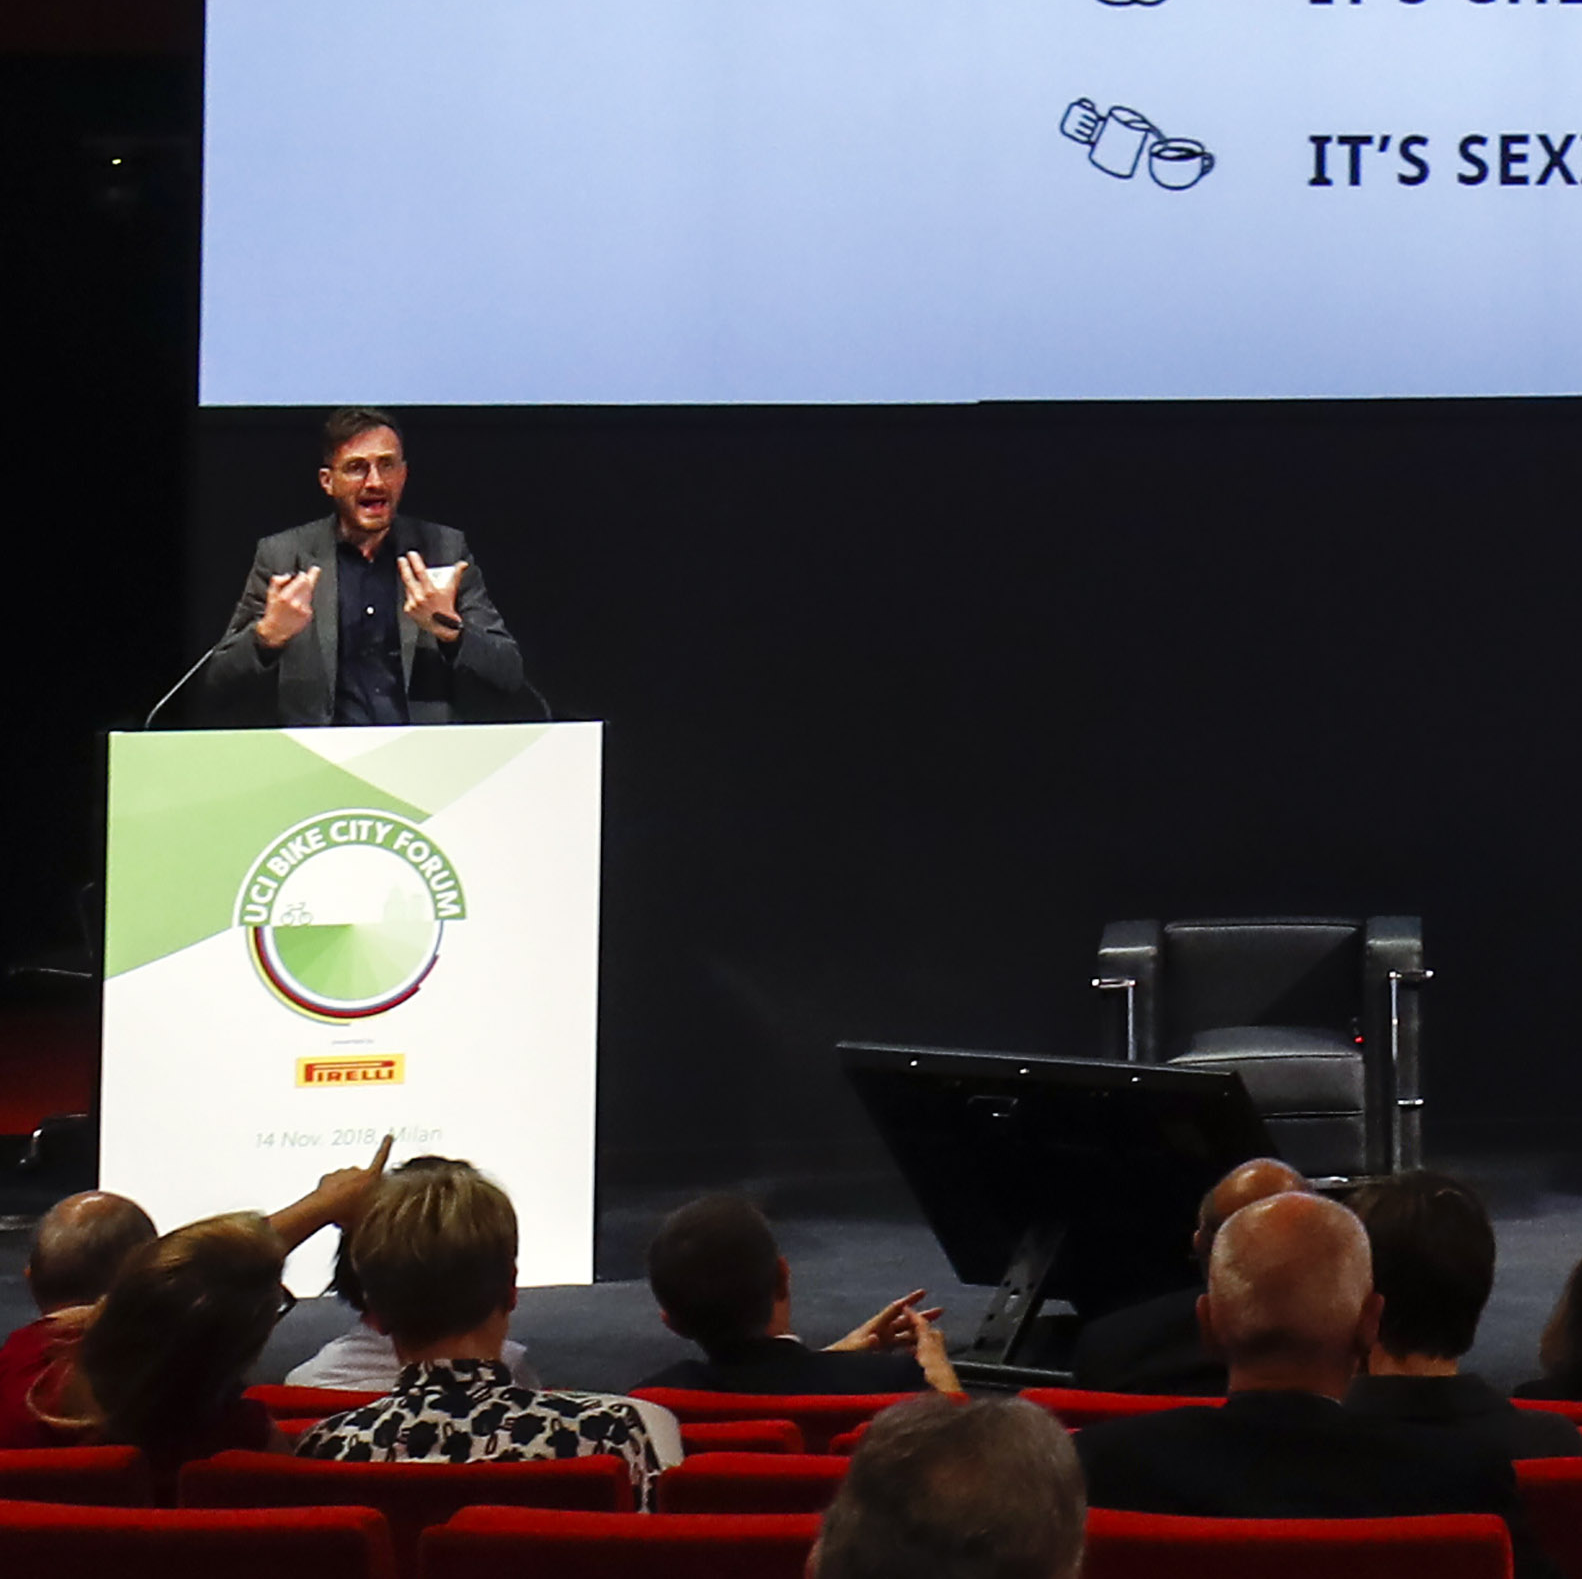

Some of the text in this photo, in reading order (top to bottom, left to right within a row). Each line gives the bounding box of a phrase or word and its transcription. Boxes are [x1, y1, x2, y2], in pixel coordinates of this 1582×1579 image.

[1308, 135, 1430, 186] IT’S
[244, 820, 461, 923] UCI BIKE CITY FORUM
[304, 1060, 396, 1083] PIRELLI
[256, 1132, 275, 1149] 14
[388, 1125, 442, 1144] Milan
